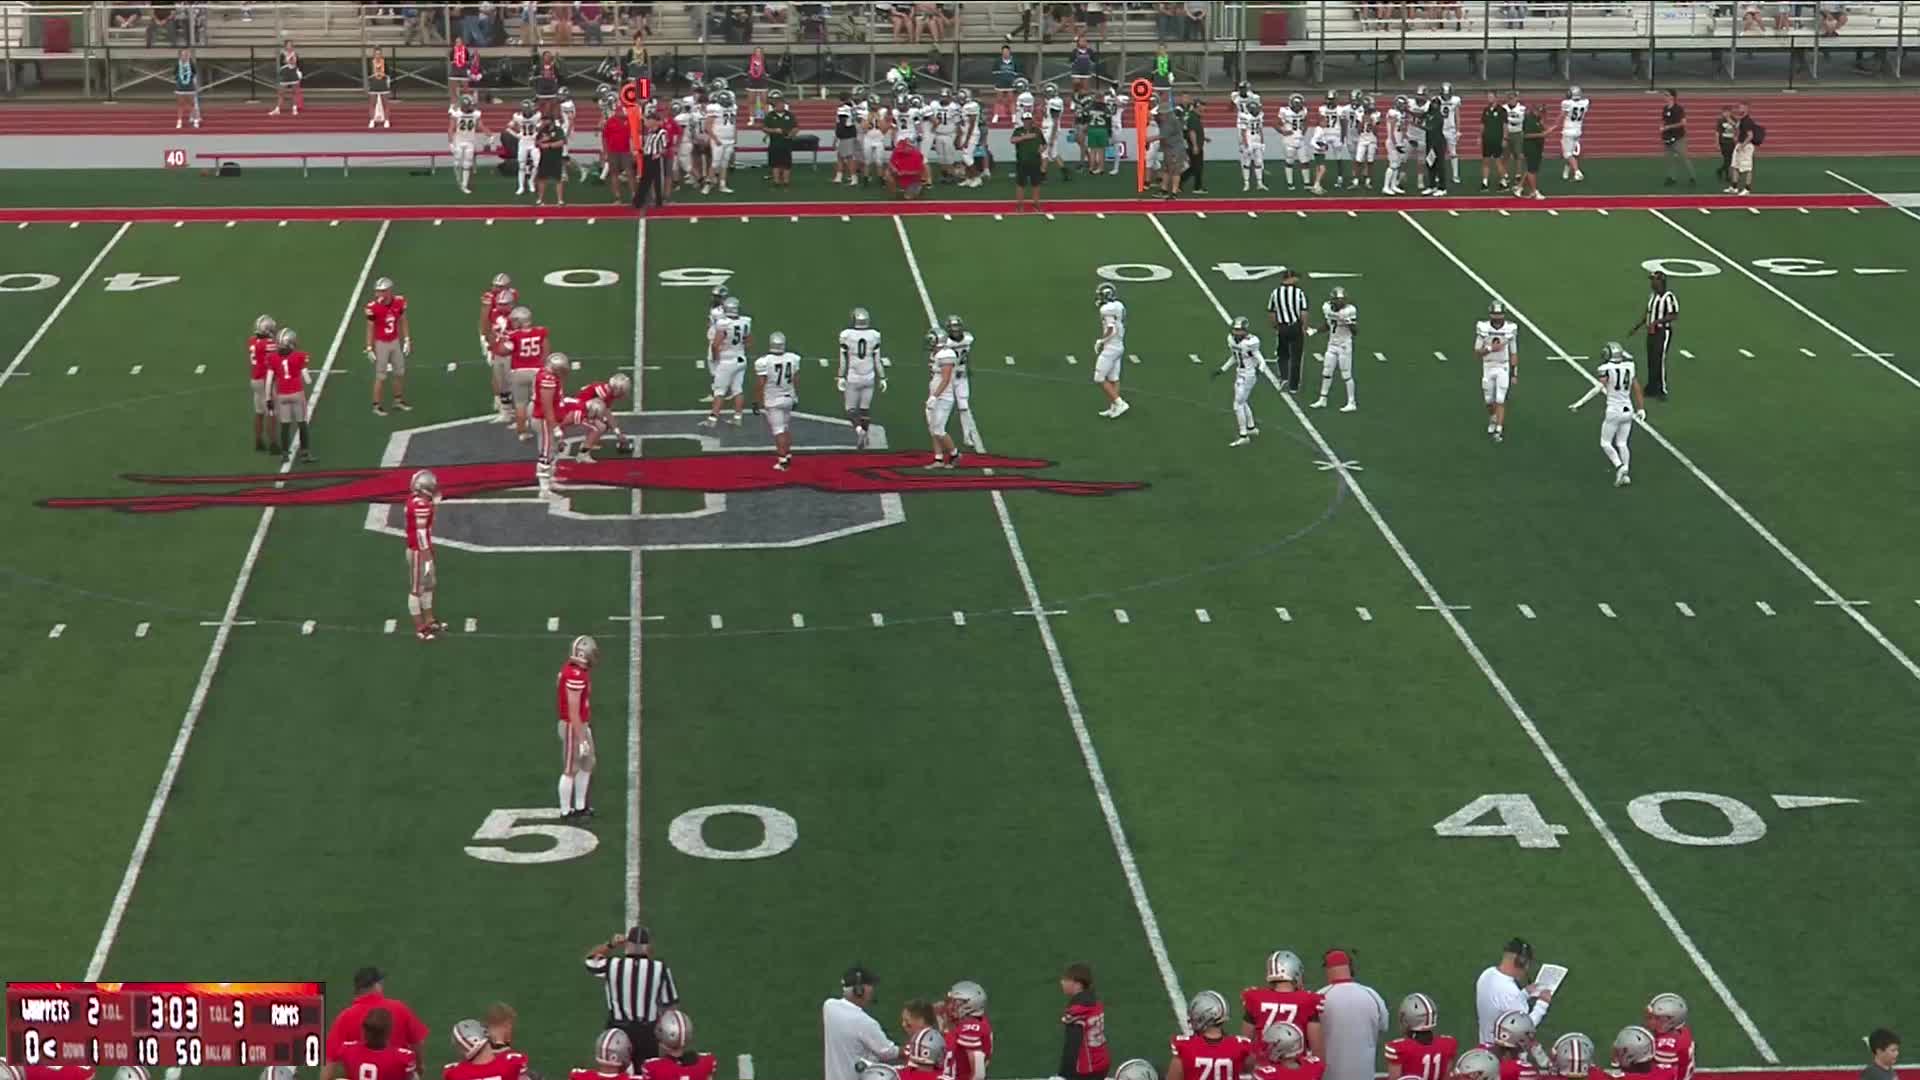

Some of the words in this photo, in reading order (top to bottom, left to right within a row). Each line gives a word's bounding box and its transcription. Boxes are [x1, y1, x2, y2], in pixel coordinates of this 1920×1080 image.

[165, 150, 184, 166] 40
[384, 316, 395, 334] 3
[520, 336, 541, 357] 55
[857, 337, 867, 360] 0
[282, 358, 291, 380] 1
[773, 361, 792, 386] 74
[1605, 368, 1628, 391] 14
[1193, 1057, 1232, 1080] 70
[1422, 1054, 1441, 1080] 11
